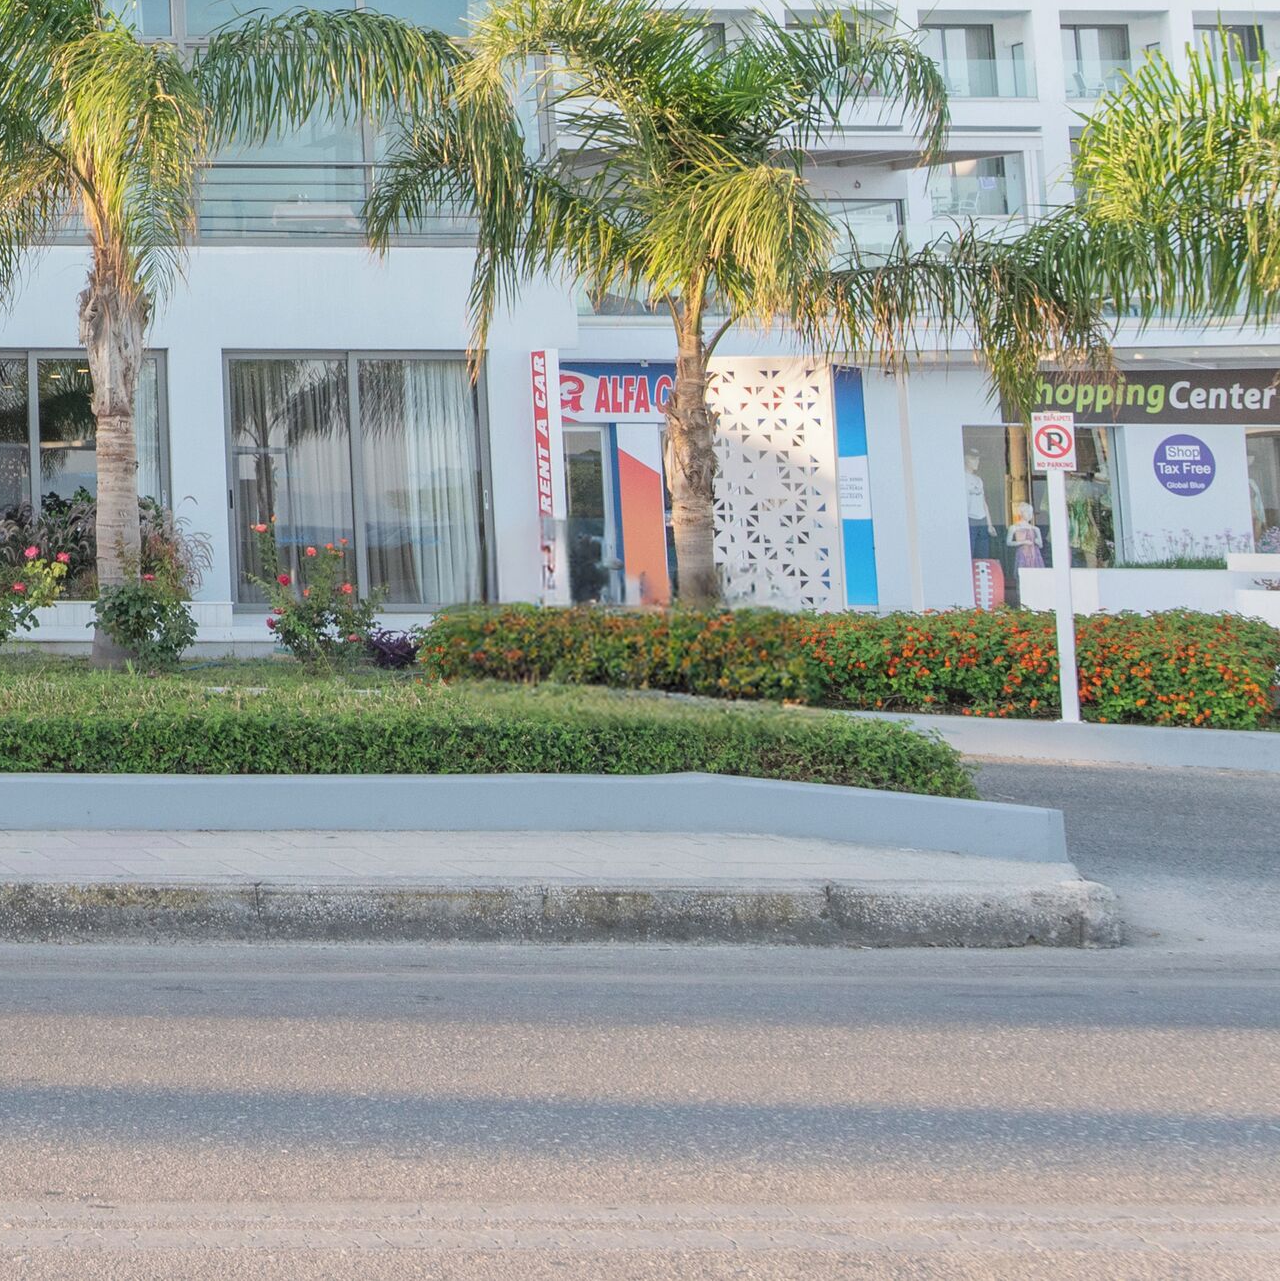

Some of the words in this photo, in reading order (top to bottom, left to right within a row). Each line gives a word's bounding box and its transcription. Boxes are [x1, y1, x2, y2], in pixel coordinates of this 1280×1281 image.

[533, 355, 547, 409] CAR
[594, 375, 651, 414] ALFA
[1034, 374, 1166, 413] hopping
[1168, 380, 1277, 410] Center
[536, 419, 549, 438] A
[1167, 446, 1200, 460] Shop
[1046, 461, 1074, 469] PARKING
[1156, 462, 1180, 474] Tax
[1182, 462, 1212, 475] Free
[538, 443, 552, 515] RENT
[1189, 481, 1207, 489] Blue
